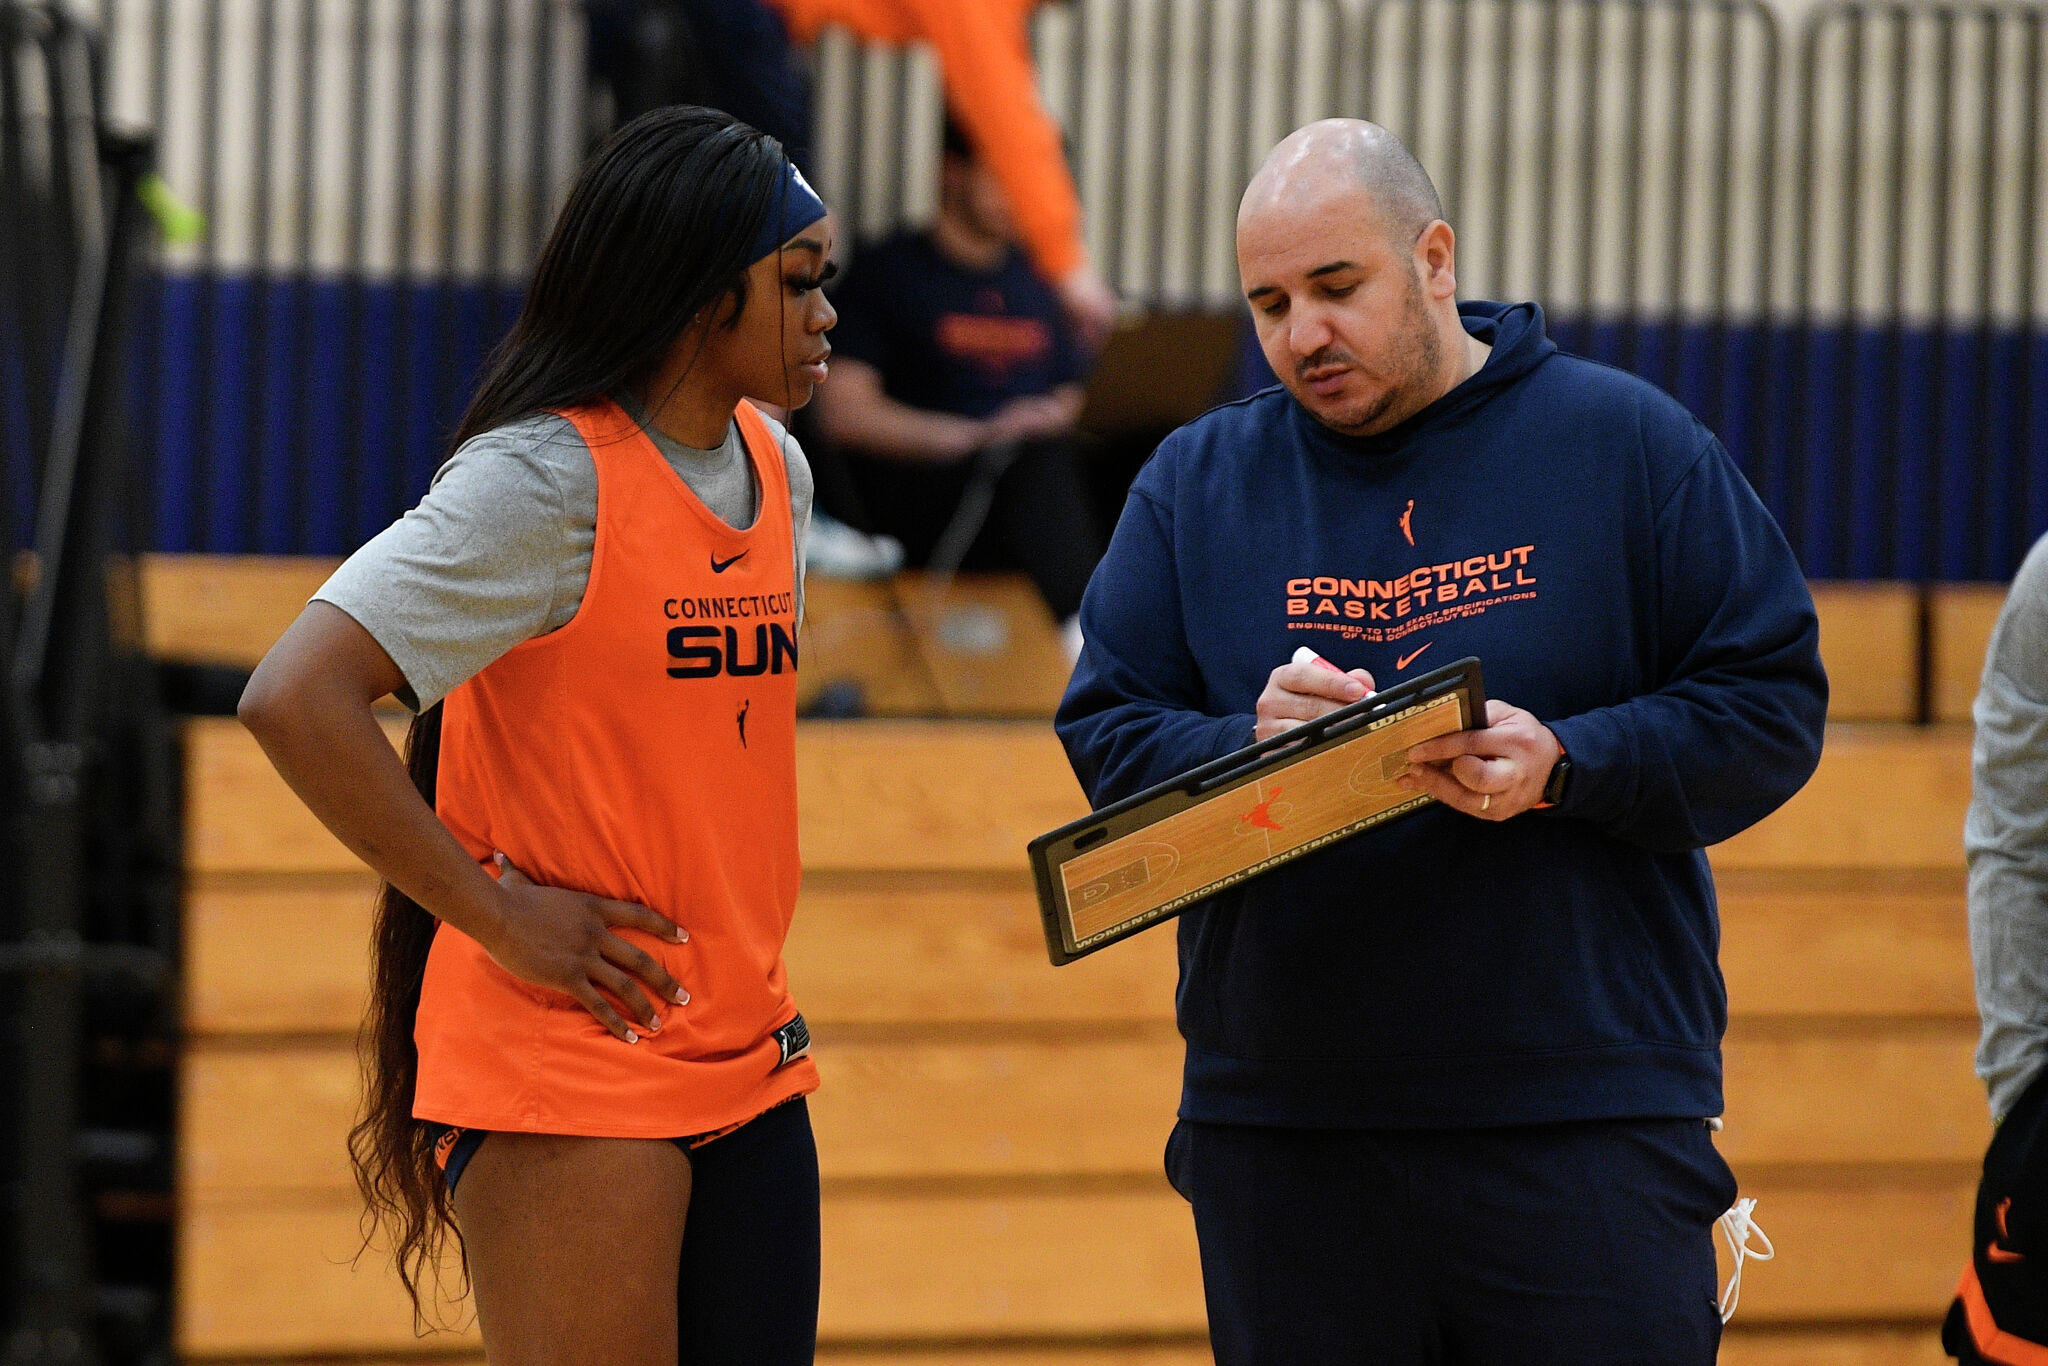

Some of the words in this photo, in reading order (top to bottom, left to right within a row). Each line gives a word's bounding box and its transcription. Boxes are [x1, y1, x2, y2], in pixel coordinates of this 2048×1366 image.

[1286, 545, 1535, 600] CONNECTICUT
[1286, 568, 1537, 620] BASKETBALL
[664, 592, 793, 620] CONNECTICUT
[1287, 621, 1363, 634] ENGINEERED
[1366, 626, 1382, 635] TO
[1384, 623, 1405, 635] THE
[1405, 611, 1440, 628] EXACT
[1442, 591, 1537, 616] SPECIFICATIONS
[1342, 631, 1359, 640] OF
[1361, 633, 1384, 642] THE
[1386, 613, 1458, 642] CONNECTICUT
[1461, 606, 1487, 618] SUN
[666, 623, 798, 679] SUN
[1368, 692, 1458, 731] Wilson
[1075, 909, 1159, 949] WOMEN'S
[1161, 873, 1246, 913] NATIONAL
[1247, 827, 1352, 875] BASKETBALL
[1354, 795, 1436, 831] ASSOCIA
